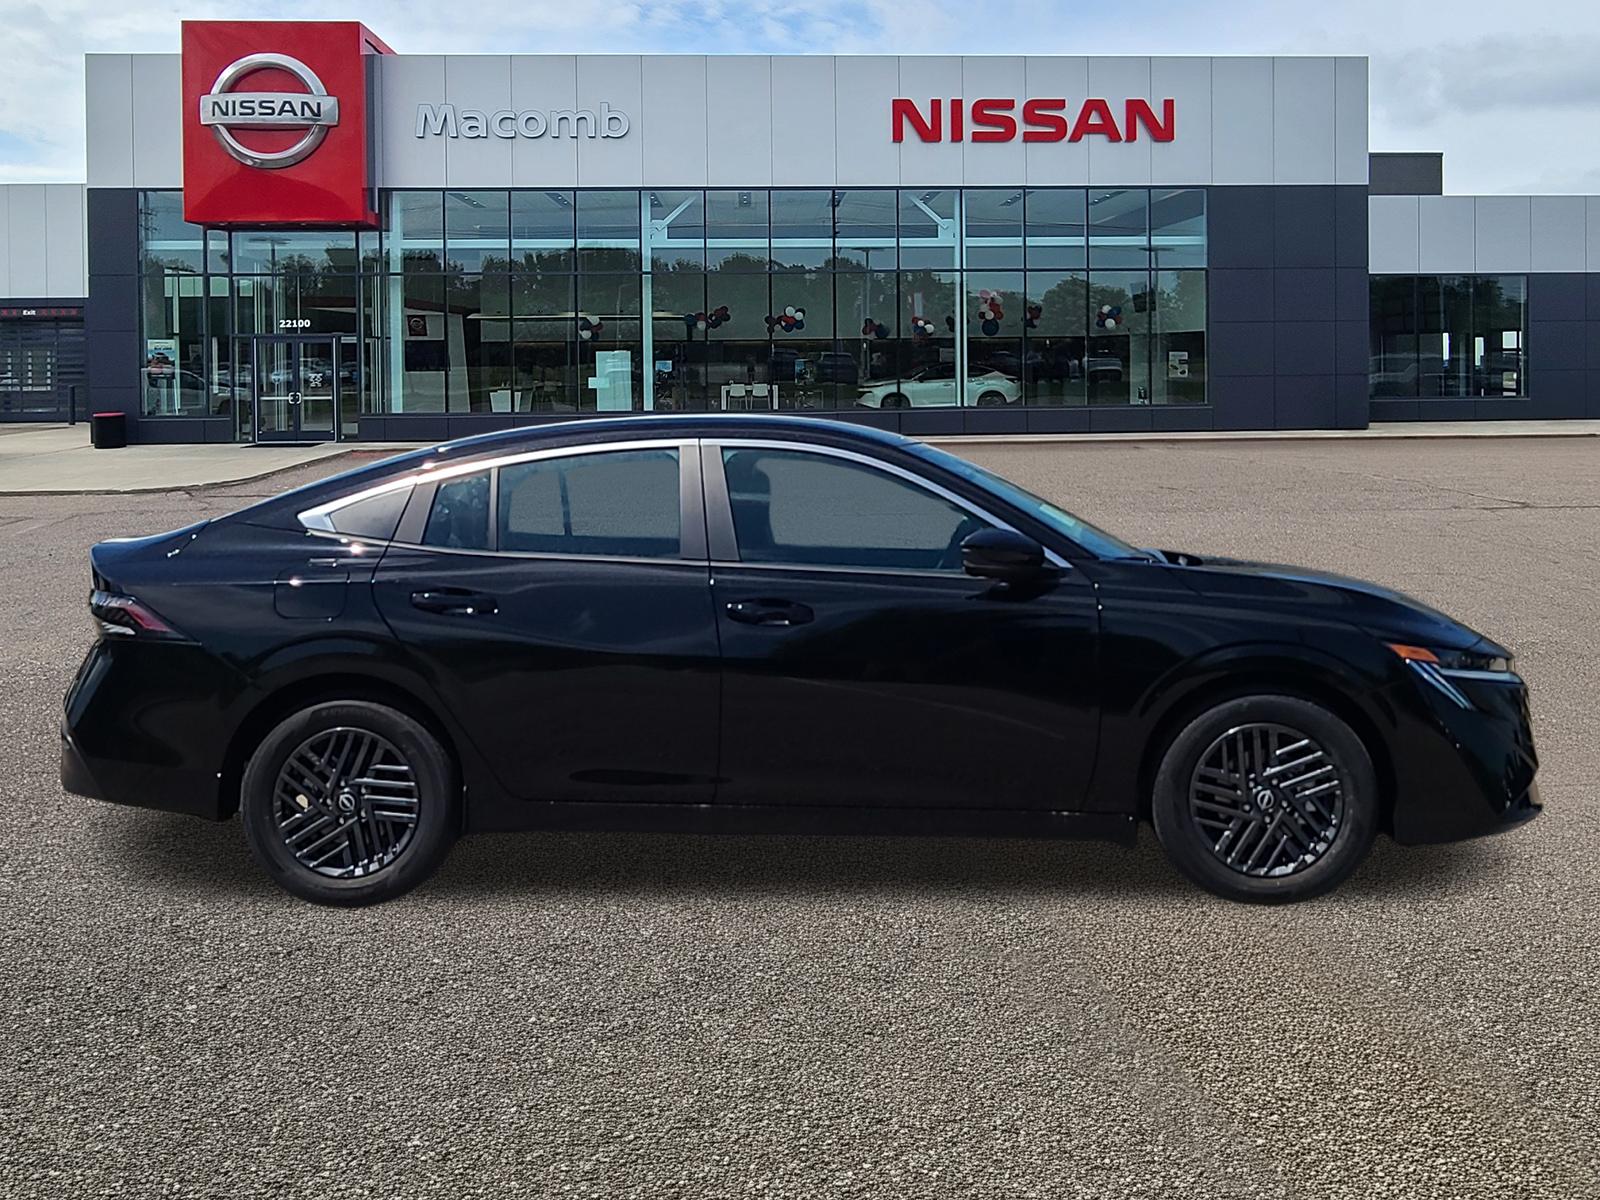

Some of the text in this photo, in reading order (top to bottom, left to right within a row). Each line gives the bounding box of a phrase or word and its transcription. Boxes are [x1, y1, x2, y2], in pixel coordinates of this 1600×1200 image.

[211, 99, 322, 118] NISSAN
[415, 102, 630, 139] Macomb
[892, 98, 1175, 143] NISSAN
[279, 319, 311, 328] 22100
